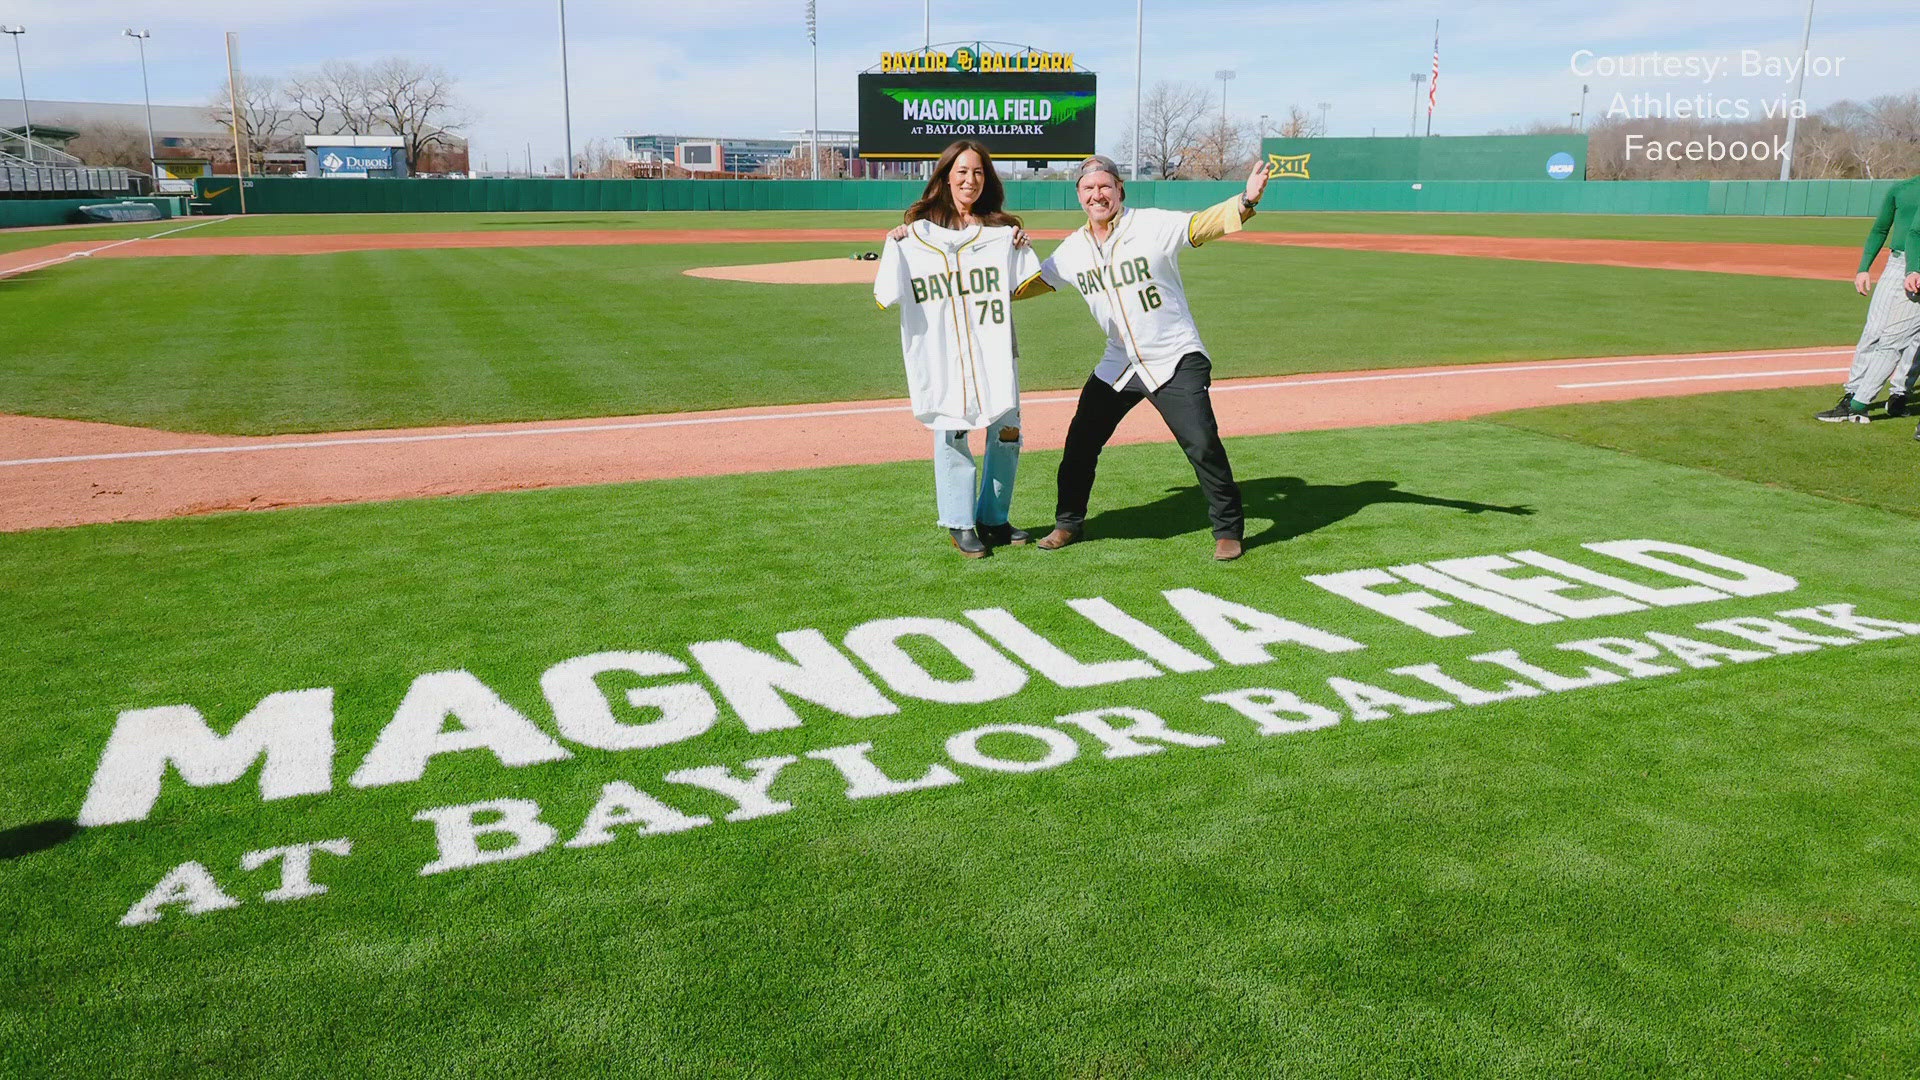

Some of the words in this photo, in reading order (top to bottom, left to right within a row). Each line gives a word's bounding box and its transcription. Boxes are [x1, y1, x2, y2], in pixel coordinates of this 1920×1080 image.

[881, 52, 948, 72] BAYLOR
[980, 52, 1075, 72] BALLPARK
[903, 98, 999, 121] MAGNOLIA
[1003, 98, 1052, 121] FIELD
[911, 126, 923, 135] AT
[925, 124, 976, 135] BAYLOR
[978, 124, 1044, 135] BALLPARK
[346, 156, 388, 167] DUBOIS
[911, 266, 1000, 304] BAYLOR
[1076, 256, 1152, 296] BAYLOR
[975, 299, 1005, 325] 78
[1137, 286, 1162, 313] 16
[79, 588, 1367, 826] MAGNOLIA
[1305, 539, 1798, 638] FIELD
[121, 838, 352, 925] AT
[414, 705, 1225, 875] BAYLOR
[1202, 602, 1920, 736] BALLPARK
